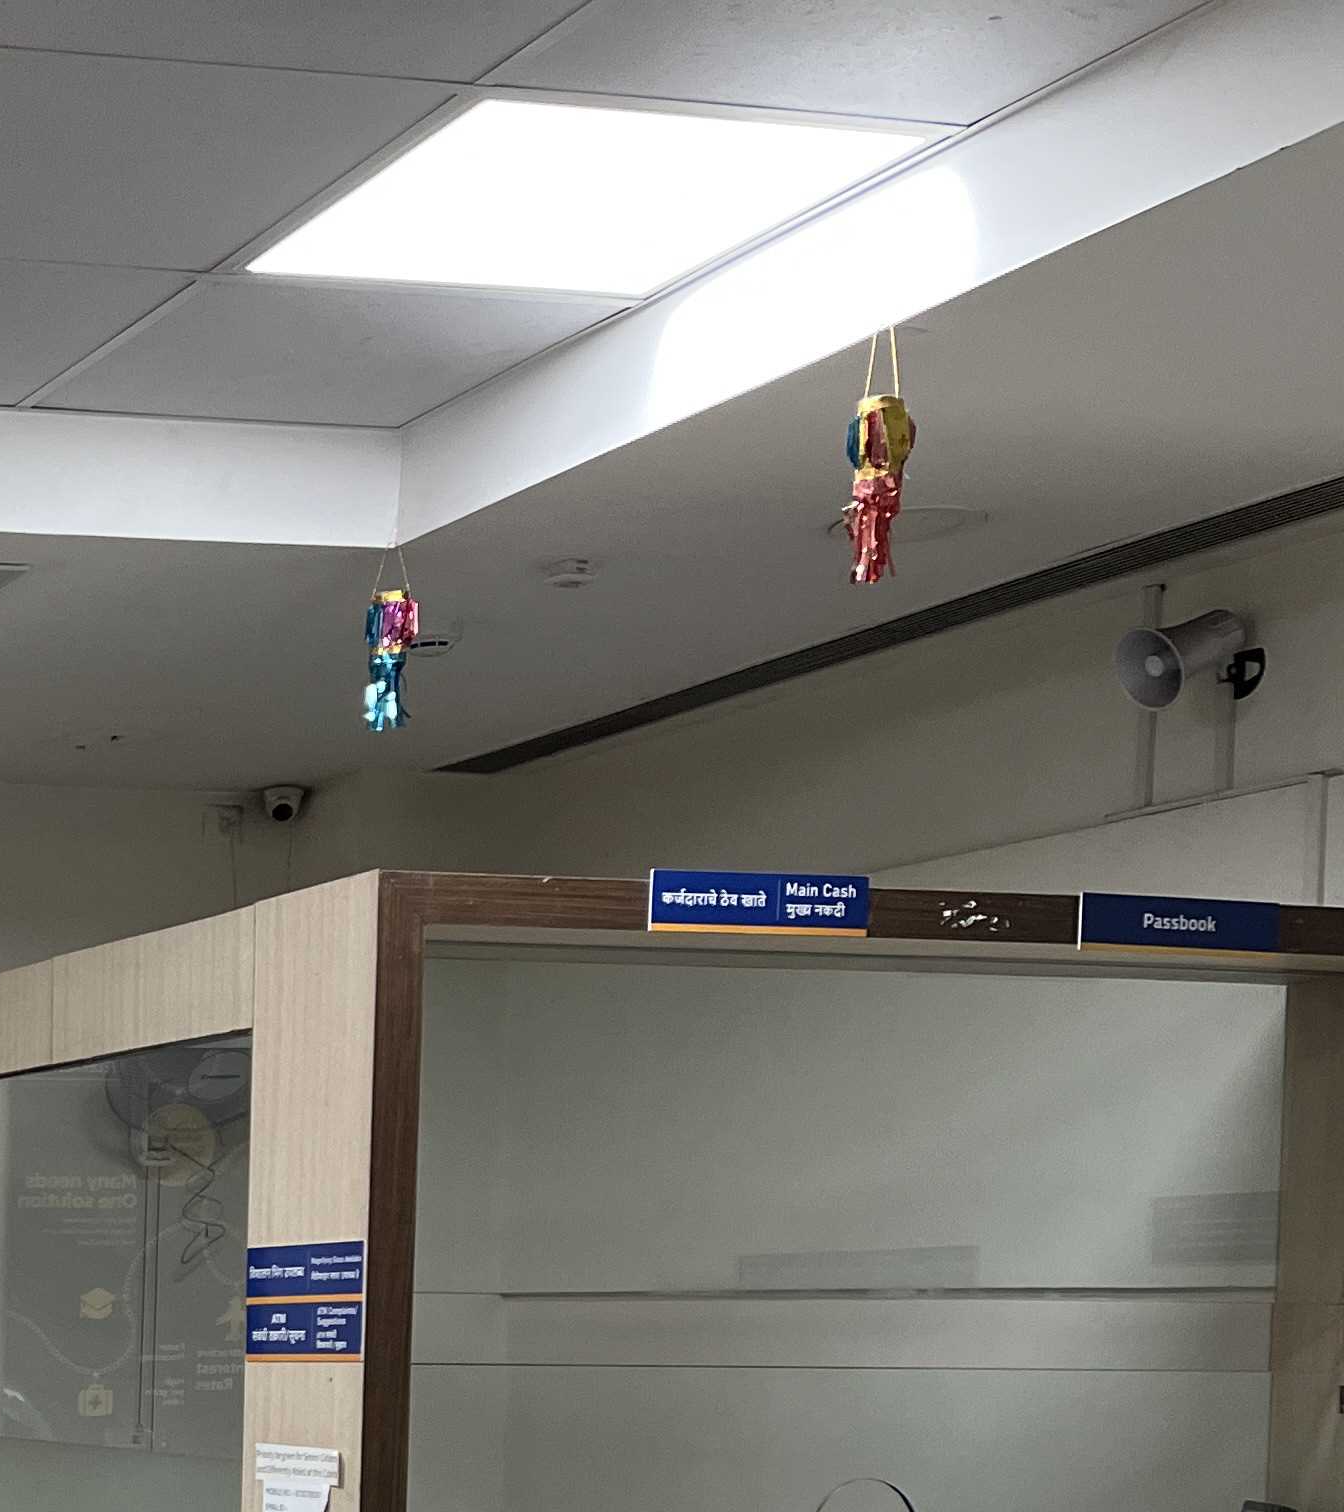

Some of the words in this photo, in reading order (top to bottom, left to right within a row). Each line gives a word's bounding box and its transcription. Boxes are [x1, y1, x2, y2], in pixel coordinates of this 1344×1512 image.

[662, 887, 717, 907] कर्जदाराचे
[720, 889, 738, 907] ठेव
[741, 890, 768, 908] खाते
[785, 881, 819, 898] Main
[822, 883, 857, 899] Cash
[785, 902, 812, 919] मुख्य
[814, 901, 846, 918] नकदी
[1143, 912, 1217, 933] Passbook
